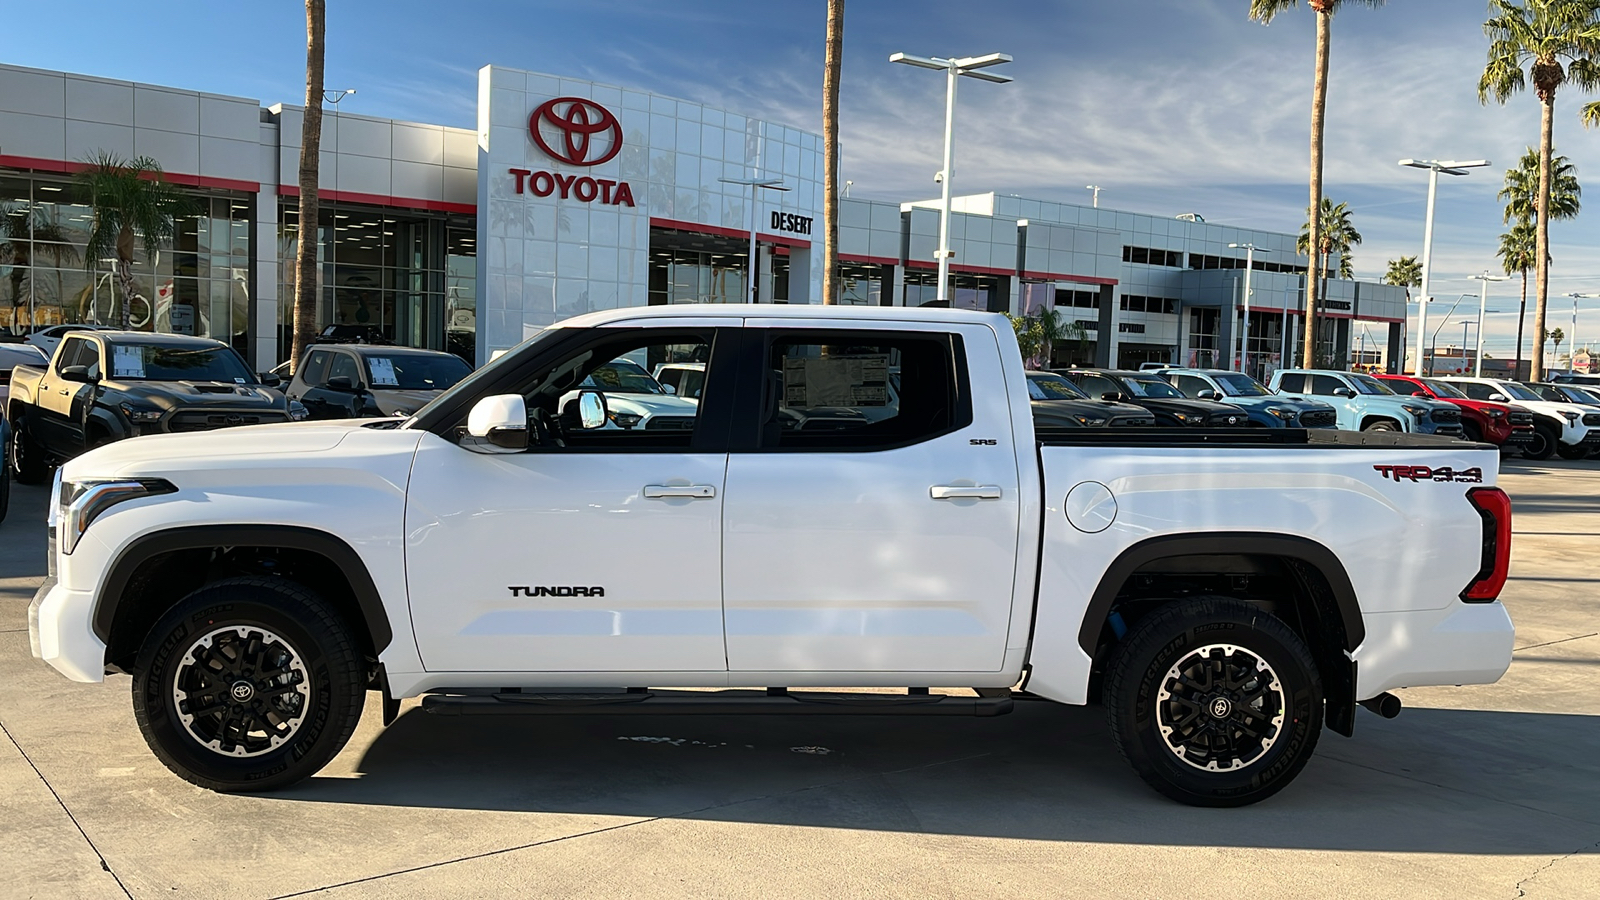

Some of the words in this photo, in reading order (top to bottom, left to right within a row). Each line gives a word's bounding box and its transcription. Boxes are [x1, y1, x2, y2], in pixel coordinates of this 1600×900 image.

[509, 168, 635, 207] TOYOTA
[771, 211, 813, 235] DESERT
[1373, 465, 1434, 483] TRD
[508, 586, 605, 597] TUNDRA
[149, 623, 187, 696] MICHELIN
[1142, 632, 1186, 697] MICHELIN
[292, 686, 332, 763] MICHELIN
[1261, 722, 1307, 782] MICHELIN
